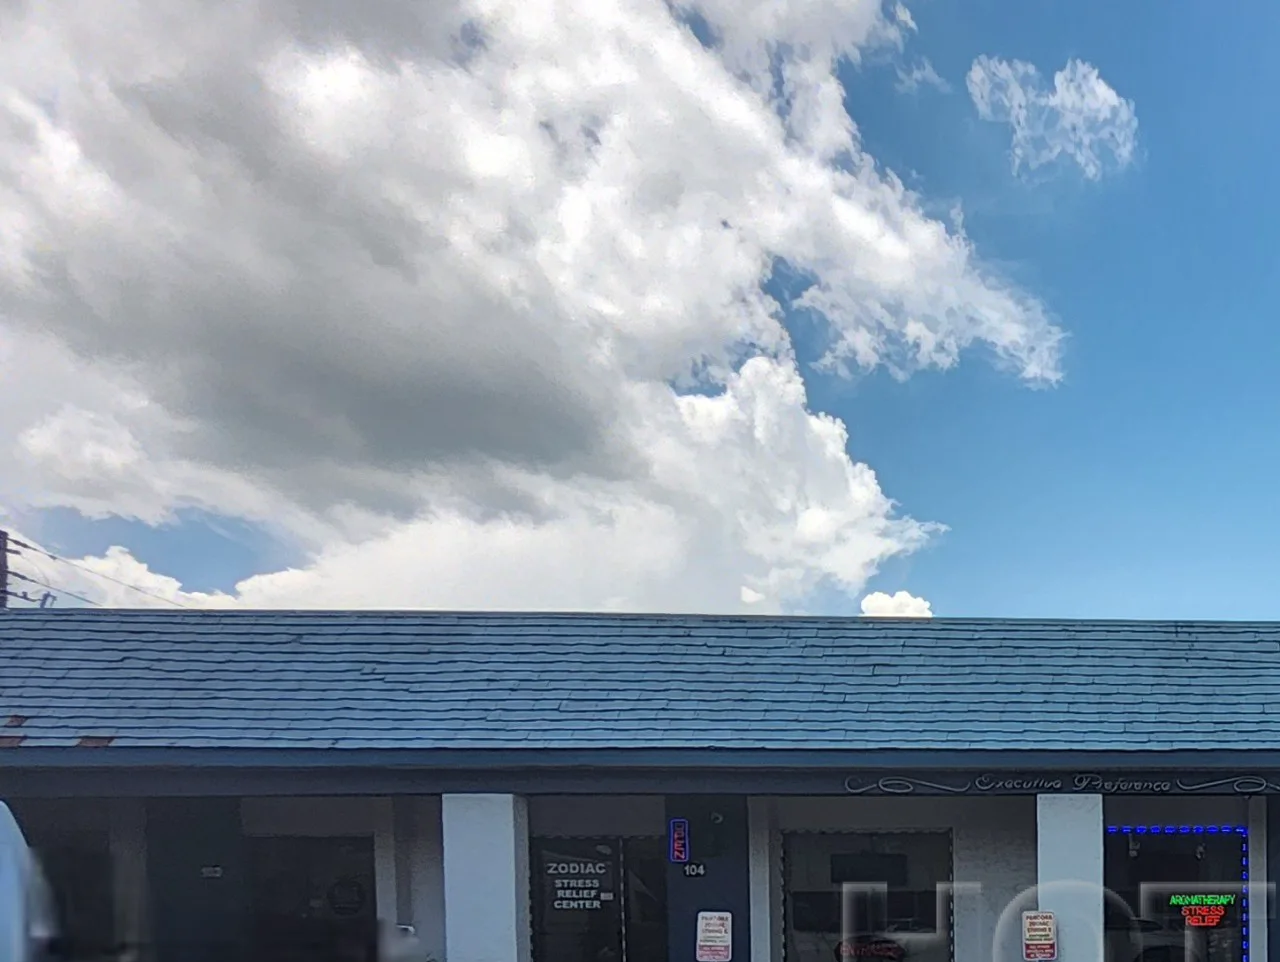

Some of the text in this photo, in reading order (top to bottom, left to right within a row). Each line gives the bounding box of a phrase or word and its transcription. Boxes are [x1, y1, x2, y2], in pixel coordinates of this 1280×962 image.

[547, 863, 606, 874] ZODIAC
[684, 865, 705, 876] 104
[554, 879, 600, 888] STRESS
[557, 889, 598, 898] RELIEF
[553, 900, 601, 909] CENTER
[1181, 905, 1225, 916] STRESS
[1184, 915, 1221, 926] RELIEF
